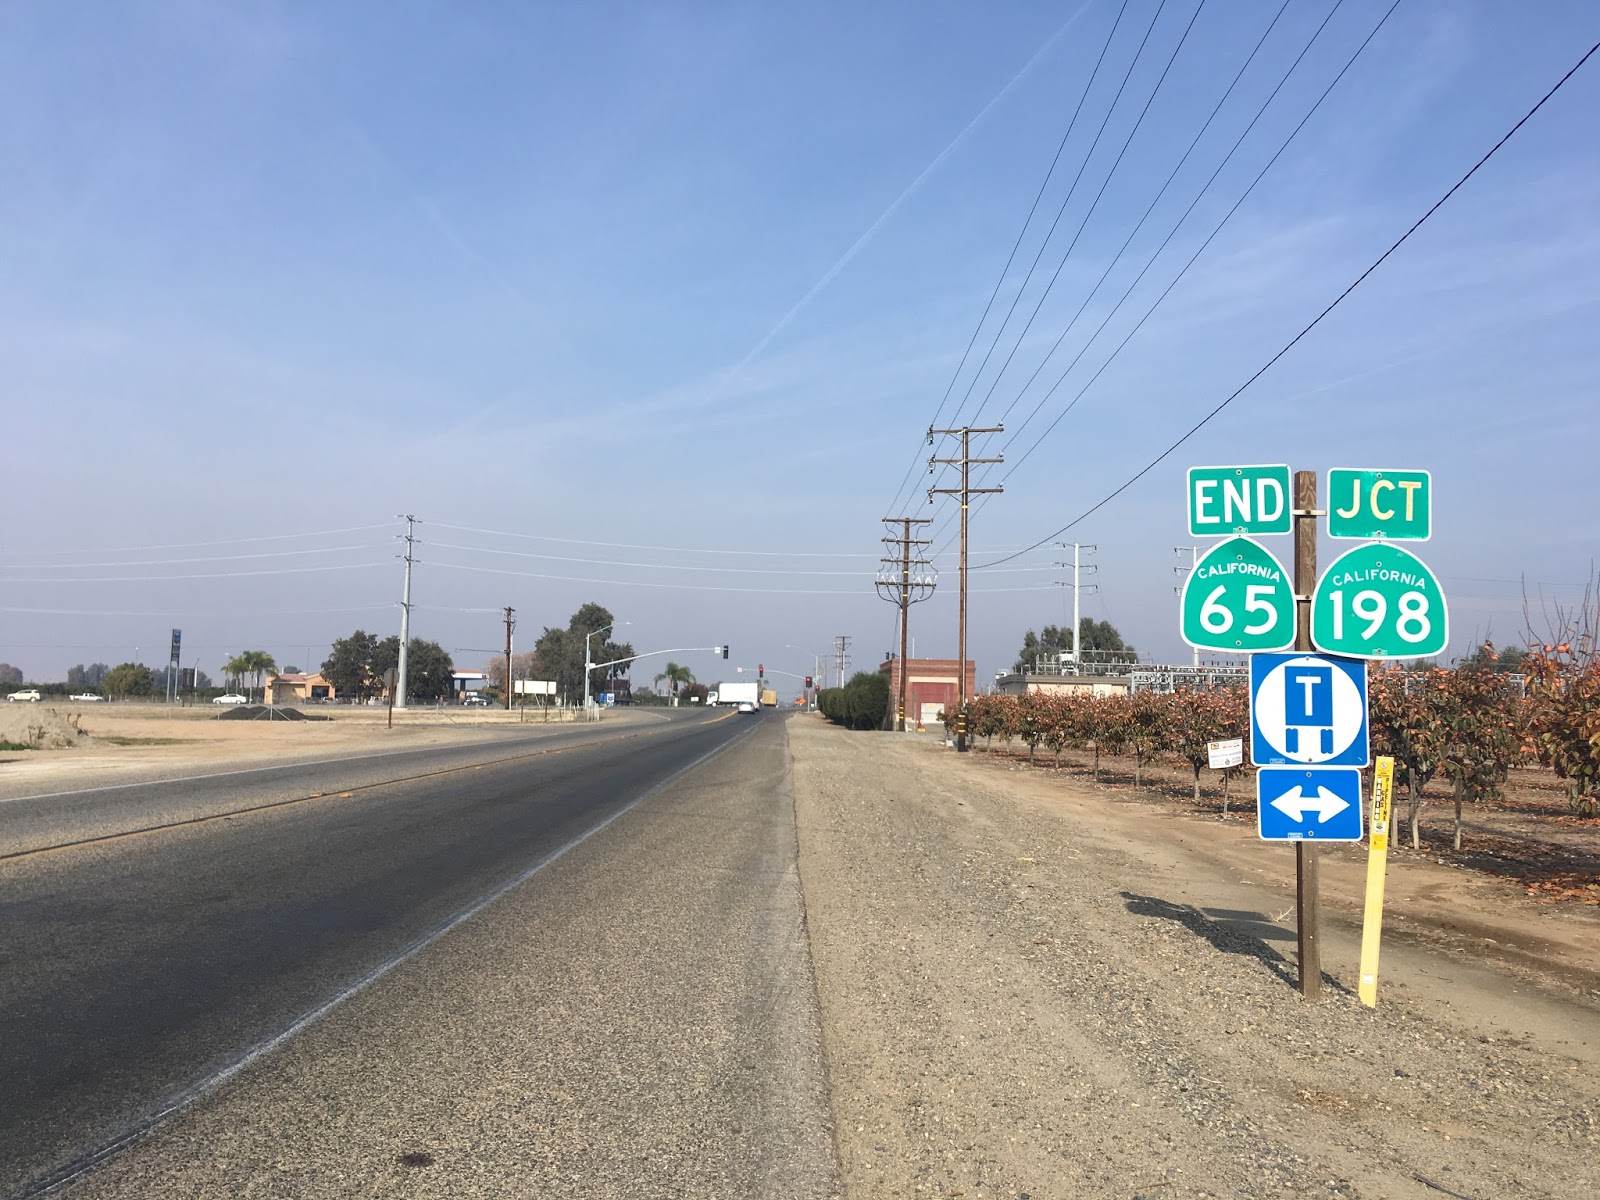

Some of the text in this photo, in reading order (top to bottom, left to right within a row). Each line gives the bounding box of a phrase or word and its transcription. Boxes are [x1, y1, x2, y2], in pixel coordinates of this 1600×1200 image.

[1195, 478, 1284, 524] END
[1336, 479, 1422, 521] JCT
[1197, 562, 1280, 582] CALIFORNIA
[1332, 569, 1425, 589] CALIFORNIA
[1200, 584, 1278, 635] 65
[1329, 590, 1431, 643] 198
[1295, 676, 1321, 716] T
